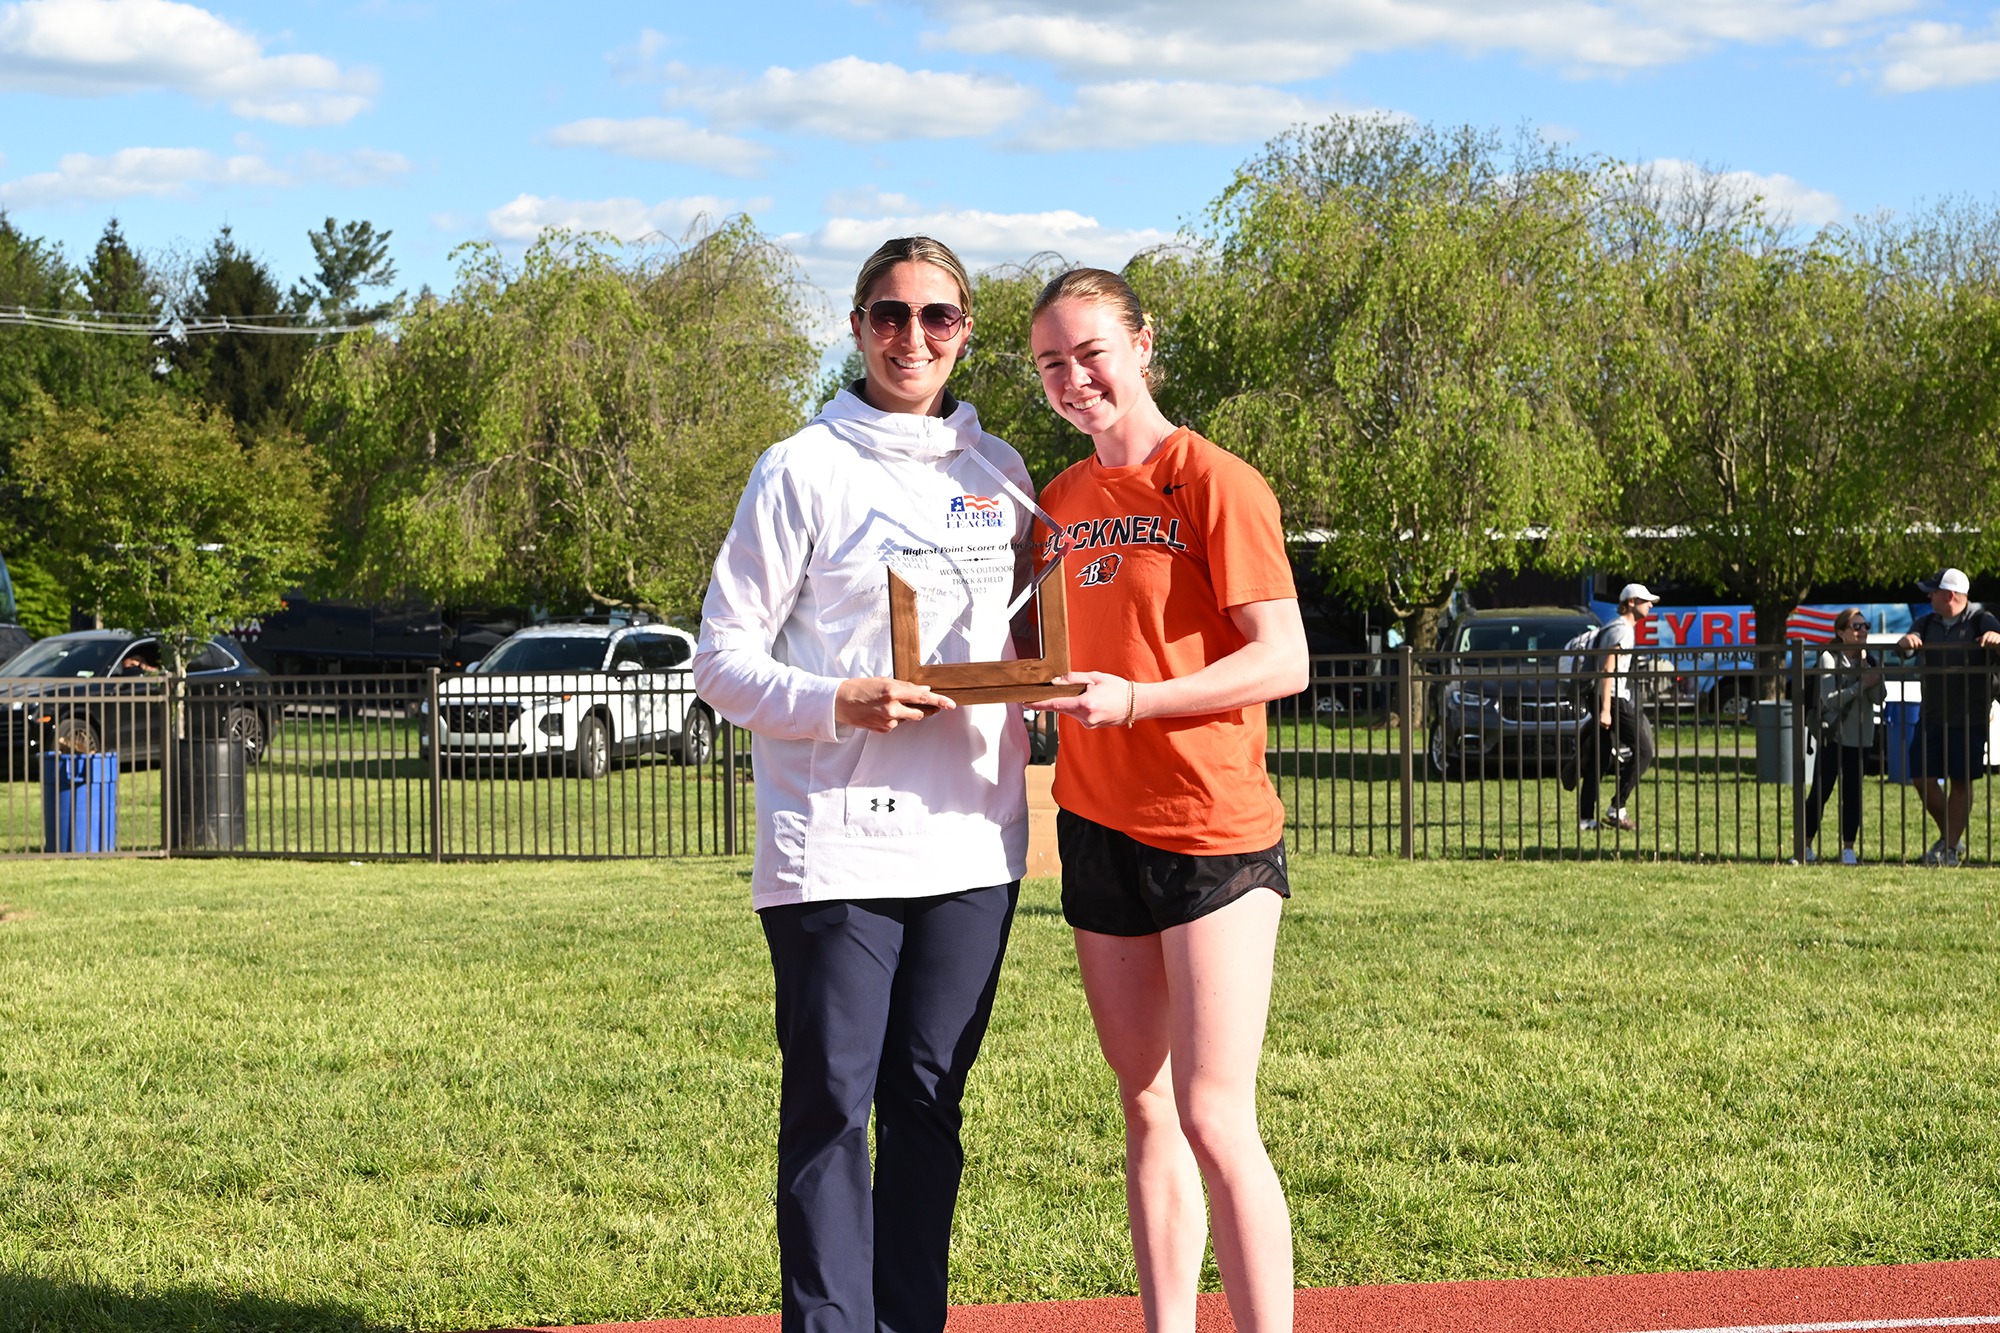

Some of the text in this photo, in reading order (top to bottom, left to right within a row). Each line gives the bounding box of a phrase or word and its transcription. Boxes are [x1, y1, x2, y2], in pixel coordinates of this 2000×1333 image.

[946, 510, 1005, 521] PATRIOT
[946, 518, 1006, 529] LEAGUE
[902, 547, 938, 557] Highest
[940, 545, 964, 554] Point
[966, 543, 995, 552] Scorer
[998, 543, 1009, 551] of
[976, 565, 1014, 574] OUTDOOR
[952, 577, 975, 585] TRACK
[983, 576, 1004, 584] FIELD
[1634, 611, 1756, 646] EYRE
